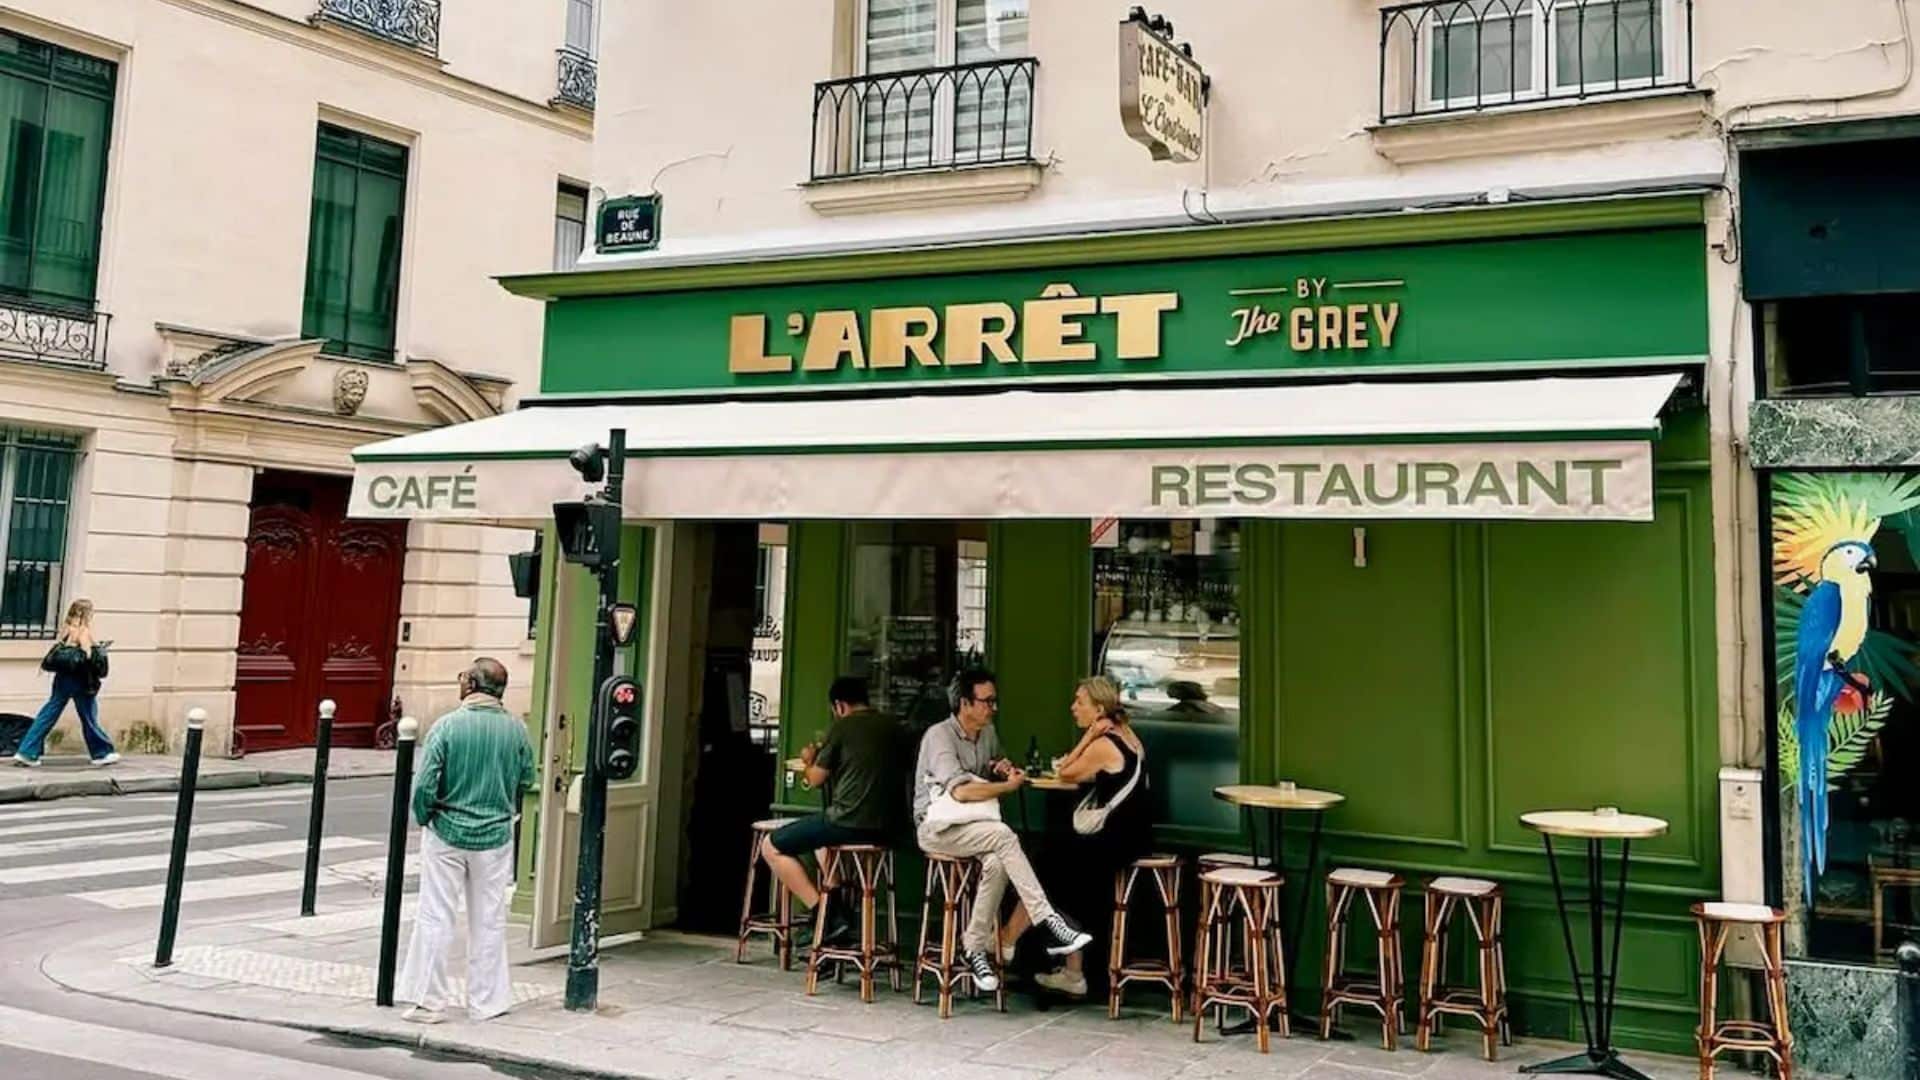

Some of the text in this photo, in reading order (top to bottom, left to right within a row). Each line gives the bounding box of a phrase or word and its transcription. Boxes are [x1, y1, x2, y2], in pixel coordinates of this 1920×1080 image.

[617, 207, 640, 220] RUE
[605, 229, 650, 244] BEAUNE
[620, 220, 636, 231] DE
[1296, 277, 1327, 299] BY
[729, 283, 1178, 373] L'ARRÊT
[1225, 302, 1399, 352] The GREY
[367, 459, 1622, 509] CAFÉ RESTAURANT
